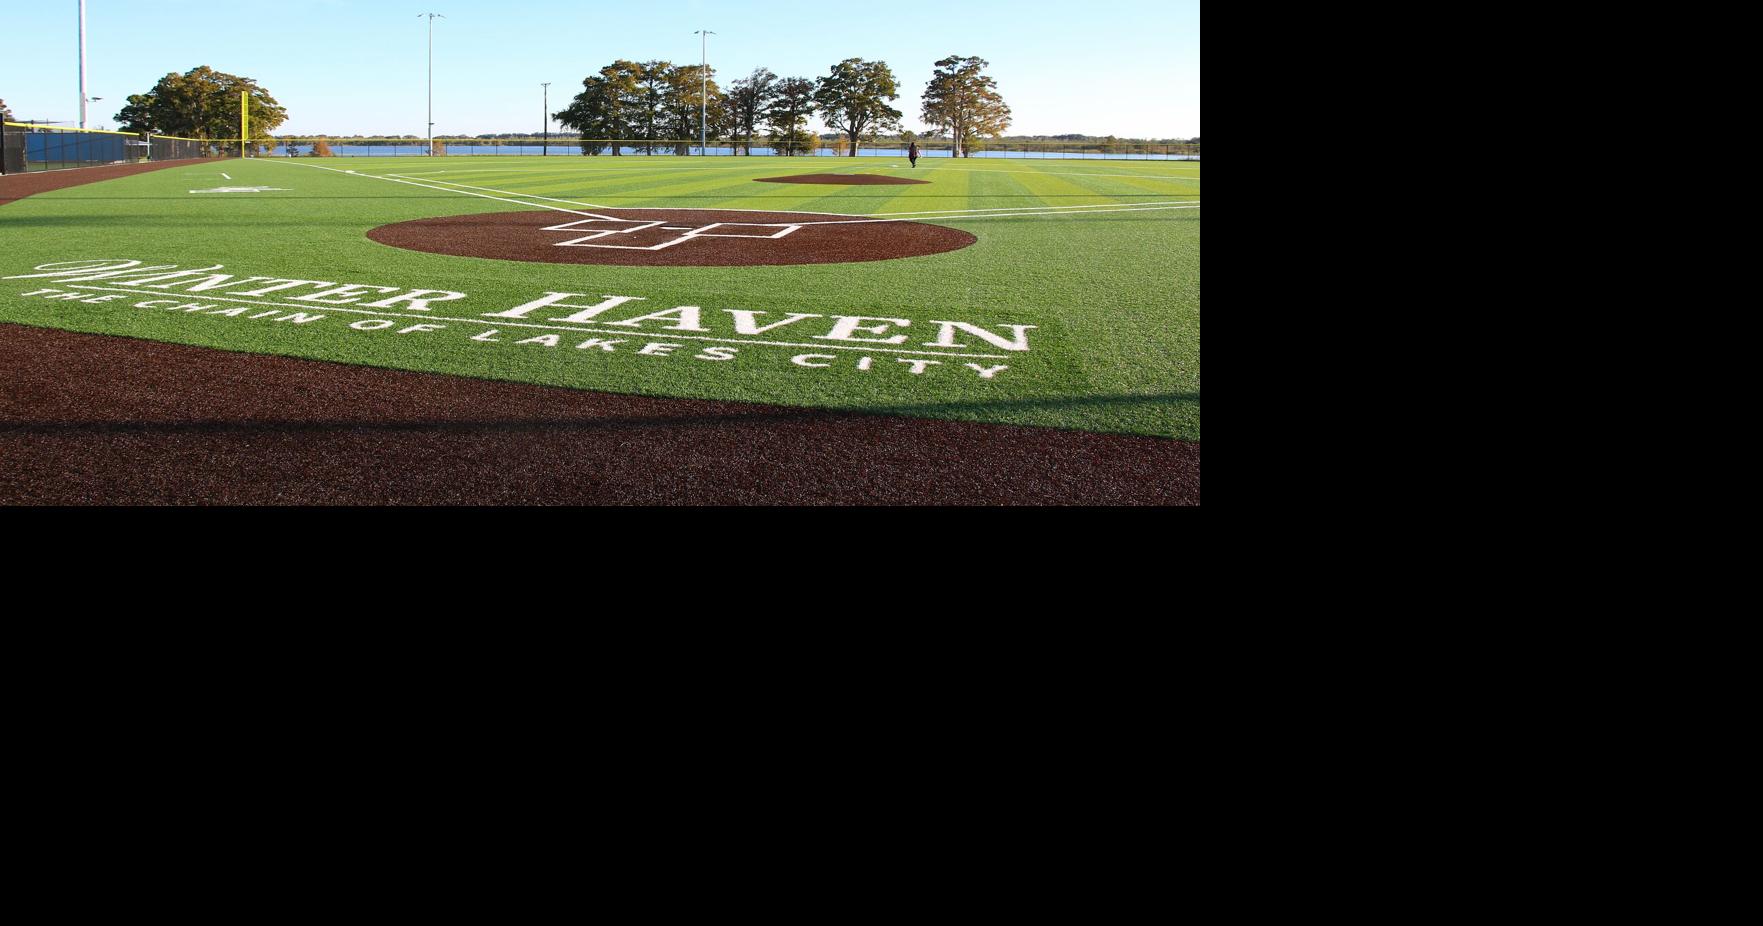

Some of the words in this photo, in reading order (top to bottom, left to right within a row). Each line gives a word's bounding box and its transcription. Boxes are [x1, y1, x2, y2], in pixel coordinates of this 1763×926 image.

[21, 289, 128, 304] THE
[134, 300, 324, 323] CHAIN
[350, 319, 446, 334] OF
[471, 329, 738, 361] LAKES
[792, 353, 1008, 379] CITY
[481, 291, 1037, 351] HAVEN
